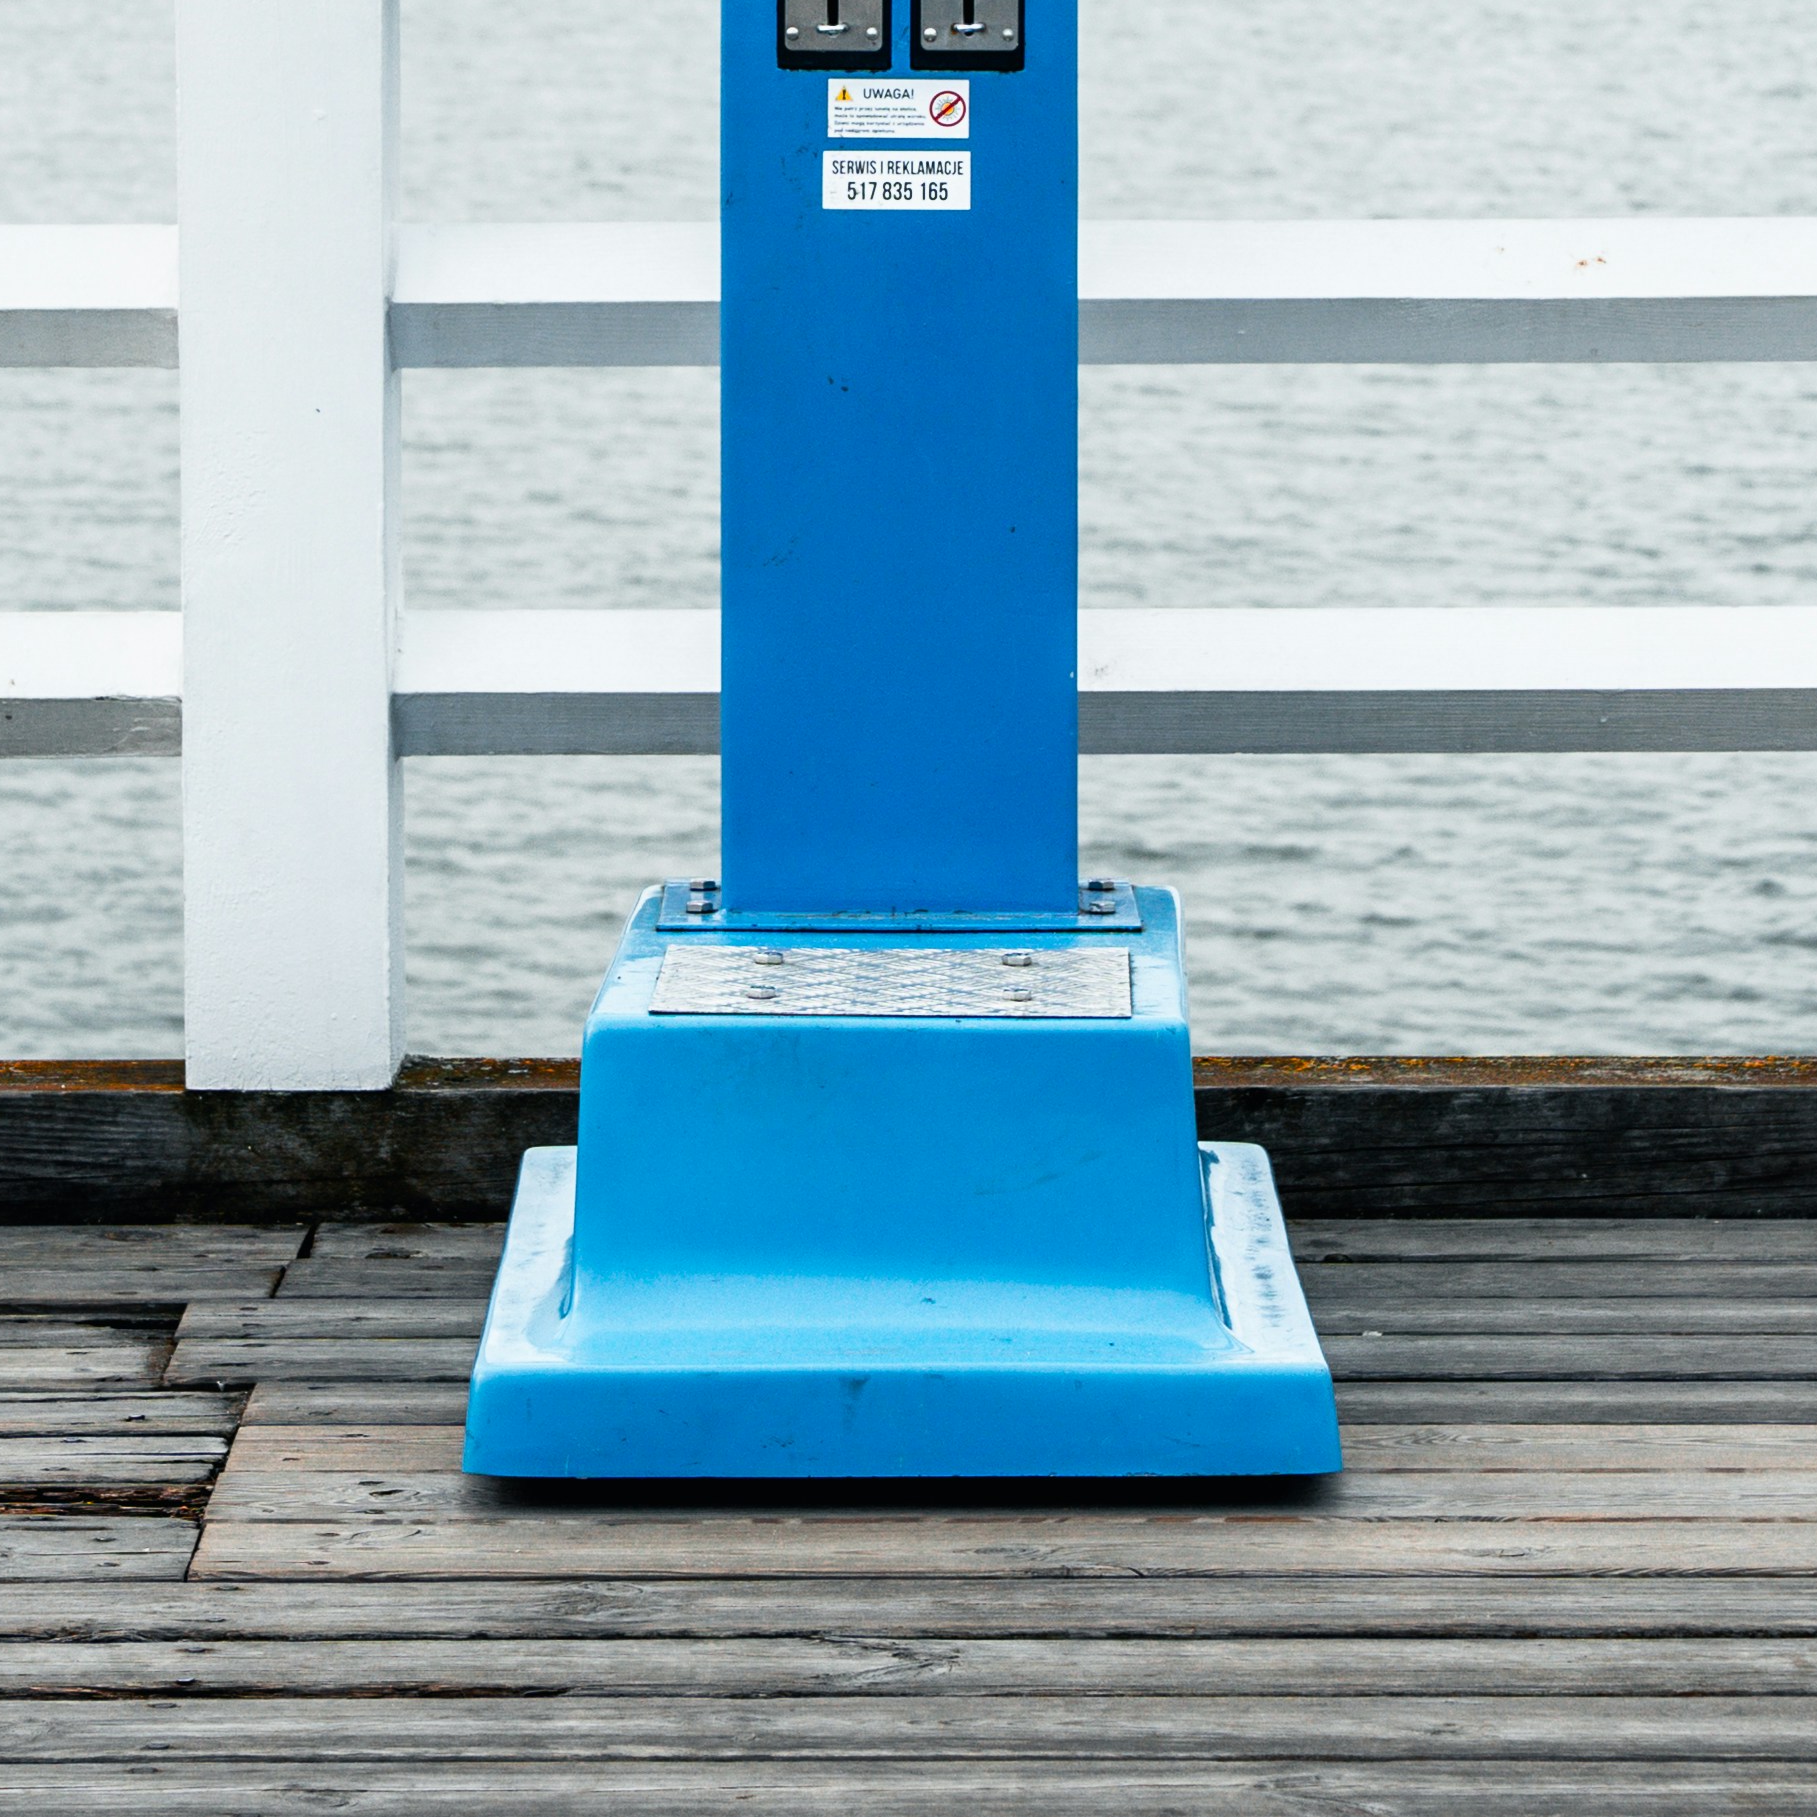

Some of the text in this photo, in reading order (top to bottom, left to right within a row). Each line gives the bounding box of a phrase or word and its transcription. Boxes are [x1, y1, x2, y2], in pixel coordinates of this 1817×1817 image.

[863, 88, 915, 99] UWAGA!
[832, 160, 877, 175] SERWIS
[887, 161, 964, 176] REKLAMACJE
[847, 182, 949, 201] 517 835 165
